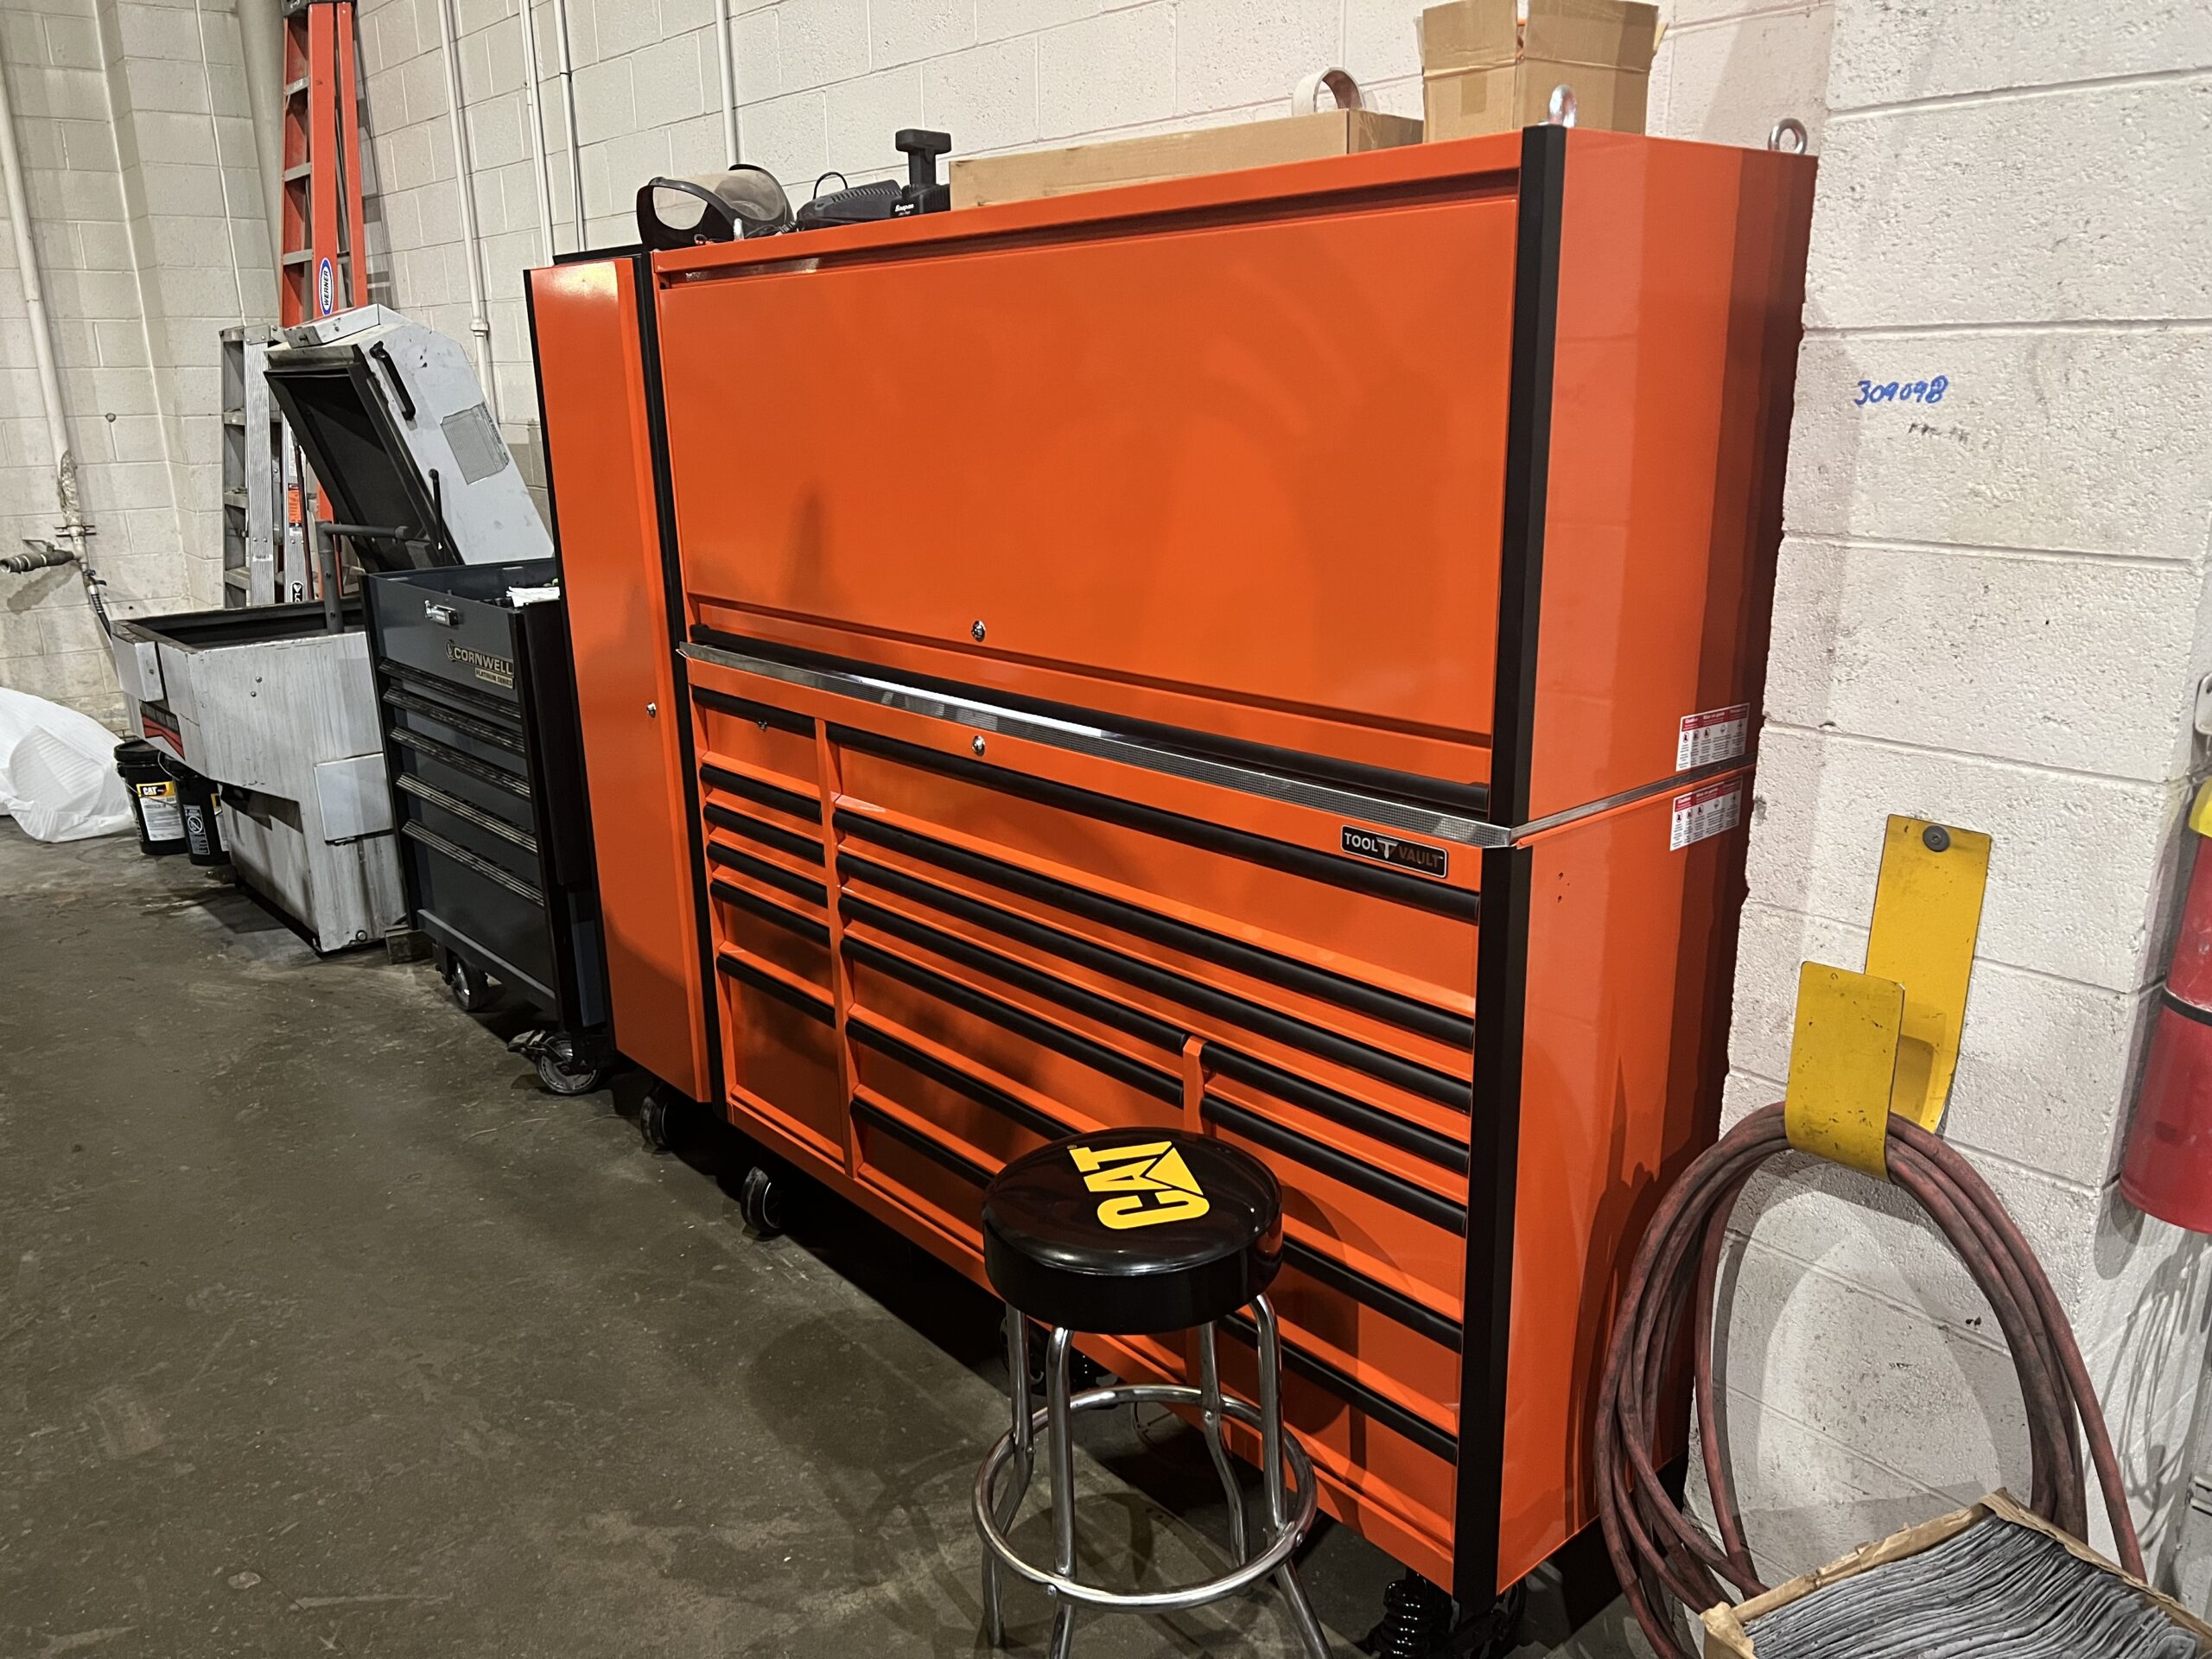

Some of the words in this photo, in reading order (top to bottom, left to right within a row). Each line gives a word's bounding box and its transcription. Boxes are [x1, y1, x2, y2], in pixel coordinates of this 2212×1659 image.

[1854, 375, 1948, 406] 309098
[454, 647, 512, 675] CORNWELL
[143, 786, 158, 796] CAT
[1344, 832, 1378, 852] TOOL
[1400, 846, 1441, 868] VAULT
[1069, 1141, 1210, 1230] CAT
